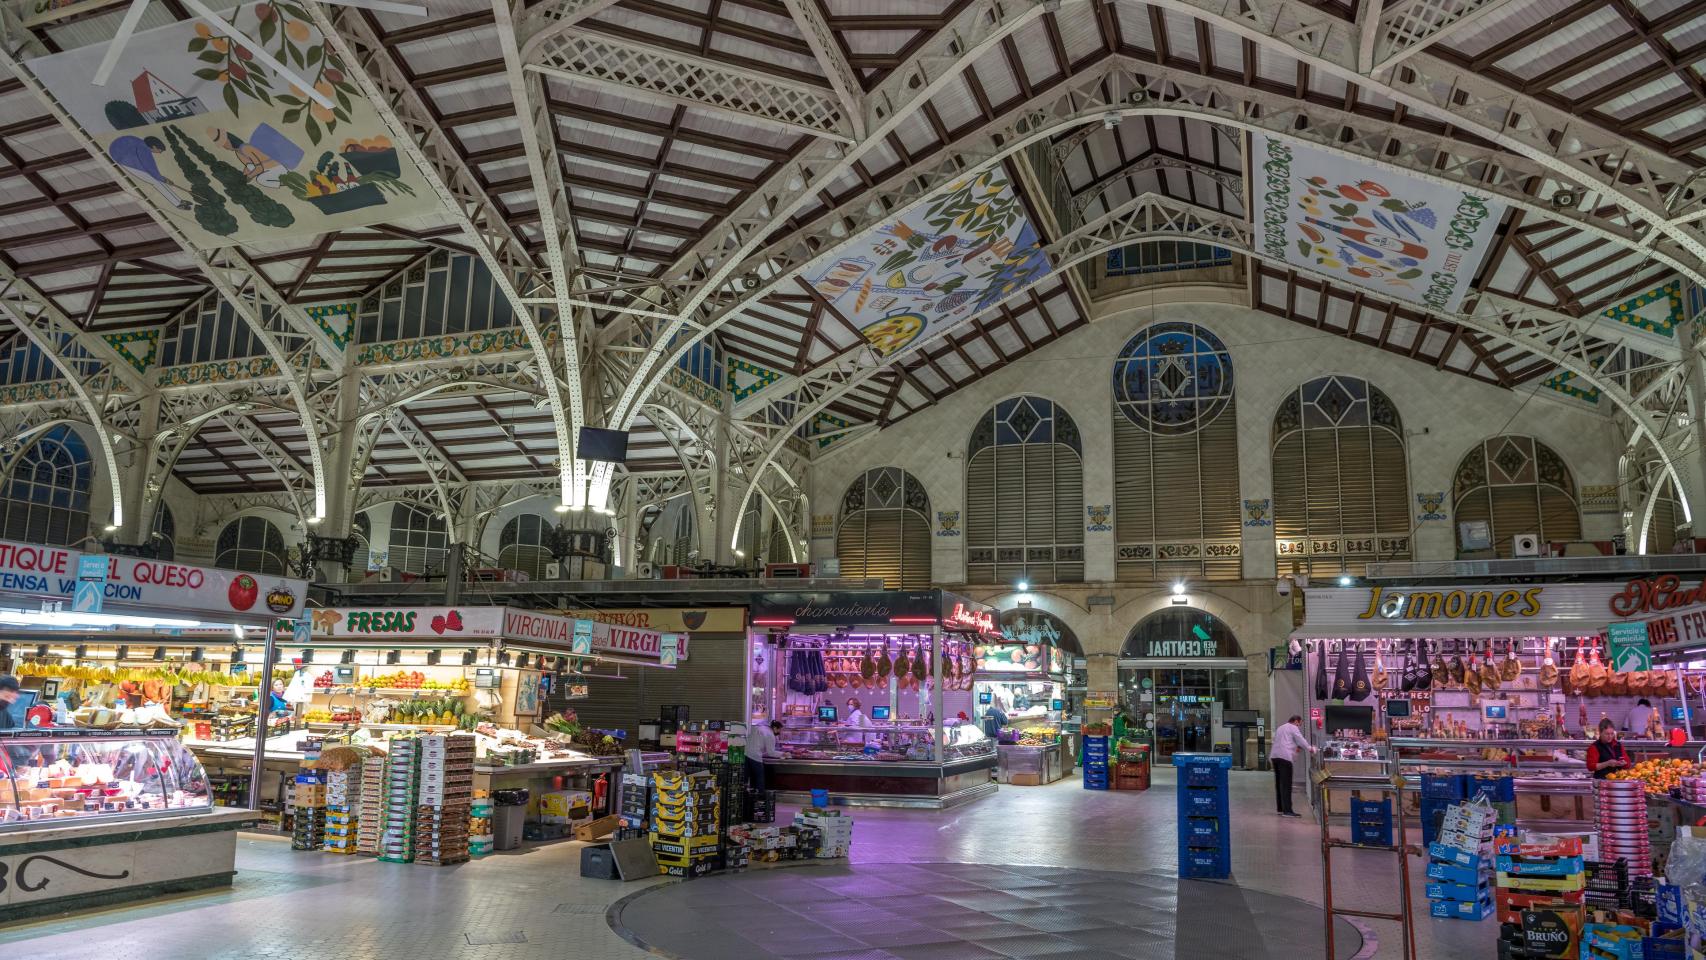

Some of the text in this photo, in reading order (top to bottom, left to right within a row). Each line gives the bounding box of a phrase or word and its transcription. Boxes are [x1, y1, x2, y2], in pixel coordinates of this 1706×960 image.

[0, 573, 48, 592] ENSA
[133, 561, 204, 589] QUESO
[1357, 586, 1544, 619] Jamones
[347, 611, 418, 634] FRESAS
[507, 613, 567, 640] VIRGINIA
[1612, 628, 1640, 636] Servicio
[610, 629, 685, 656] VIRGIA
[1613, 634, 1646, 643] domicilio
[668, 866, 683, 875] Gold
